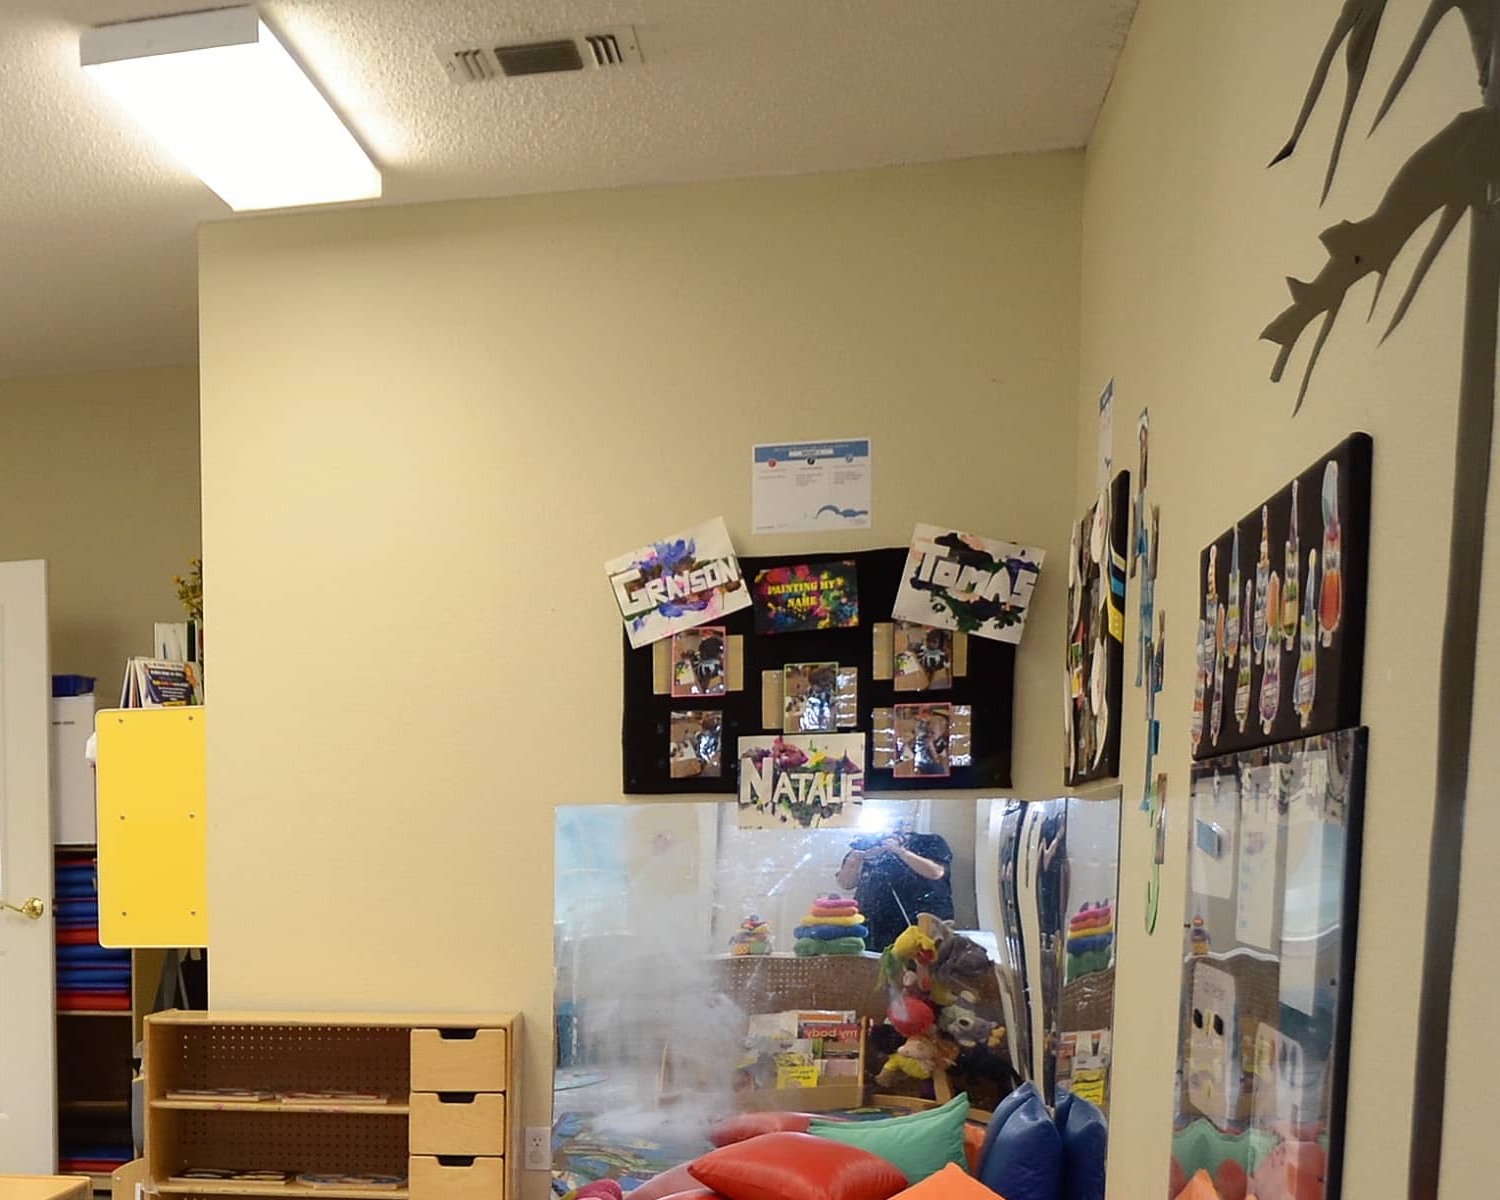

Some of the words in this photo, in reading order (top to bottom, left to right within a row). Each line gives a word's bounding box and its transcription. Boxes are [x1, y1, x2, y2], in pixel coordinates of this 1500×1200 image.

[611, 555, 739, 616] GRAYSON
[767, 582, 818, 595] PAINTING
[916, 542, 1038, 607] TOMAS
[740, 756, 864, 806] NATALIE
